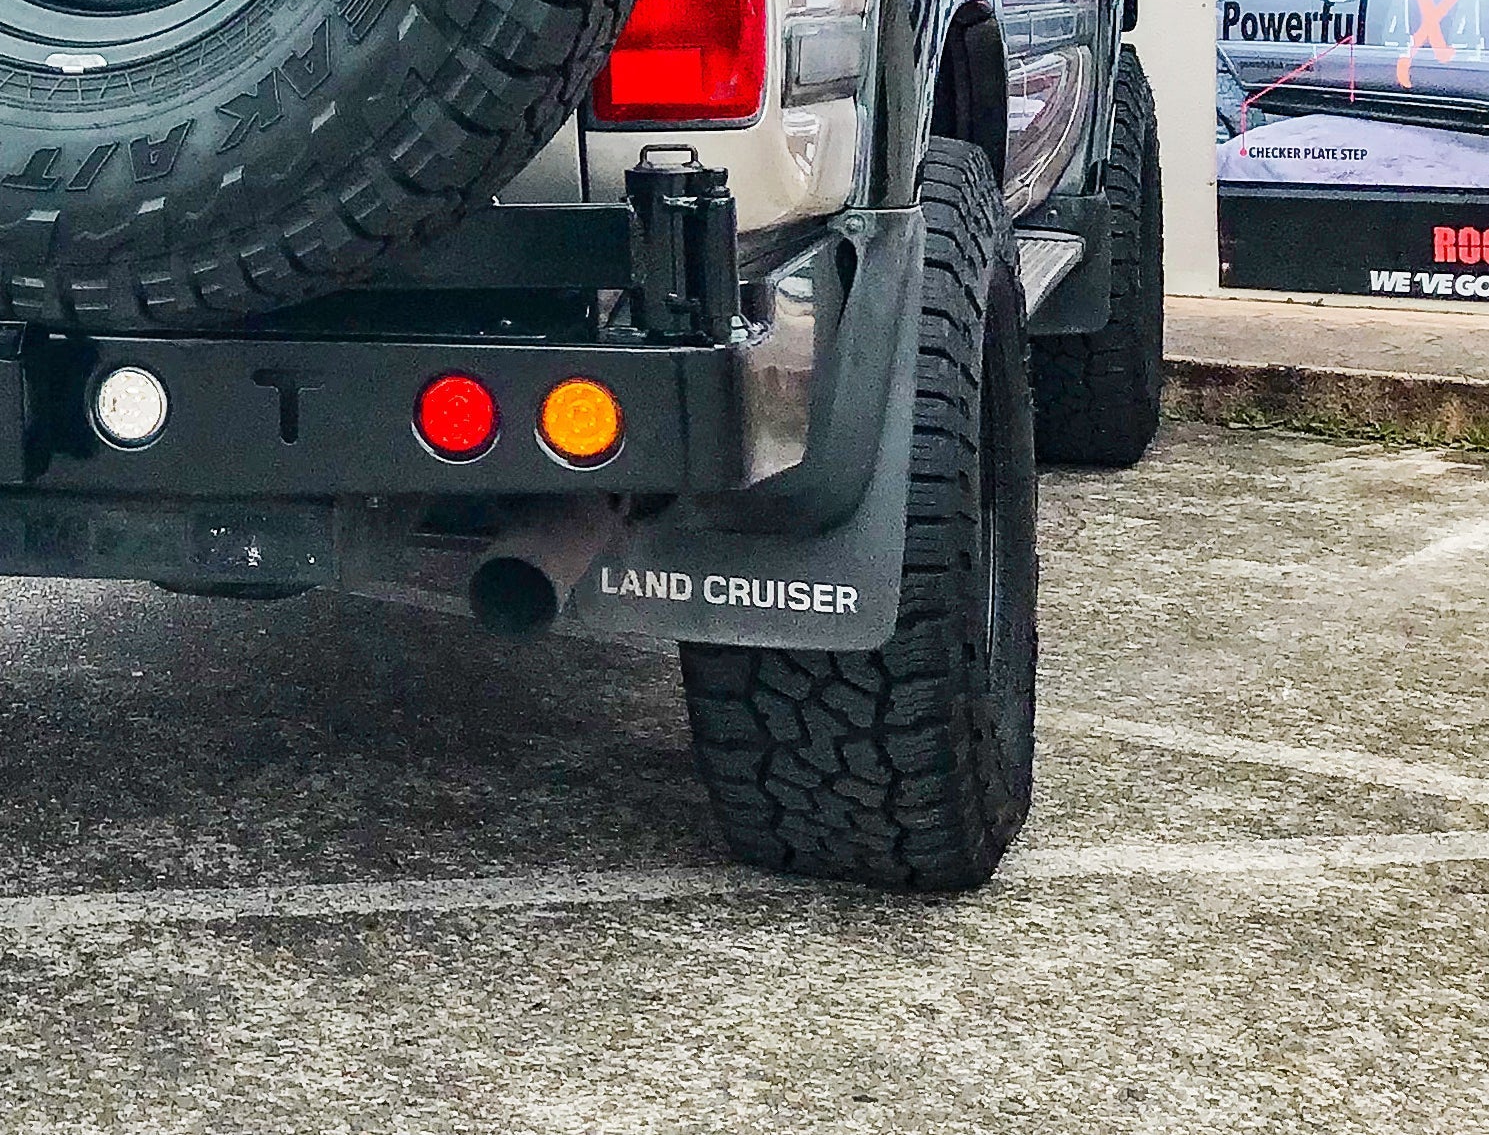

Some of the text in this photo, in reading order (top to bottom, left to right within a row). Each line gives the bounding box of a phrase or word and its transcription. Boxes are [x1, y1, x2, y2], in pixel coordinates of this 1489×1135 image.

[1249, 146, 1368, 160] CHECKER PLATE STEP
[1434, 226, 1489, 265] RO
[1370, 270, 1411, 293] WE
[600, 566, 858, 614] LAND CRUISER
